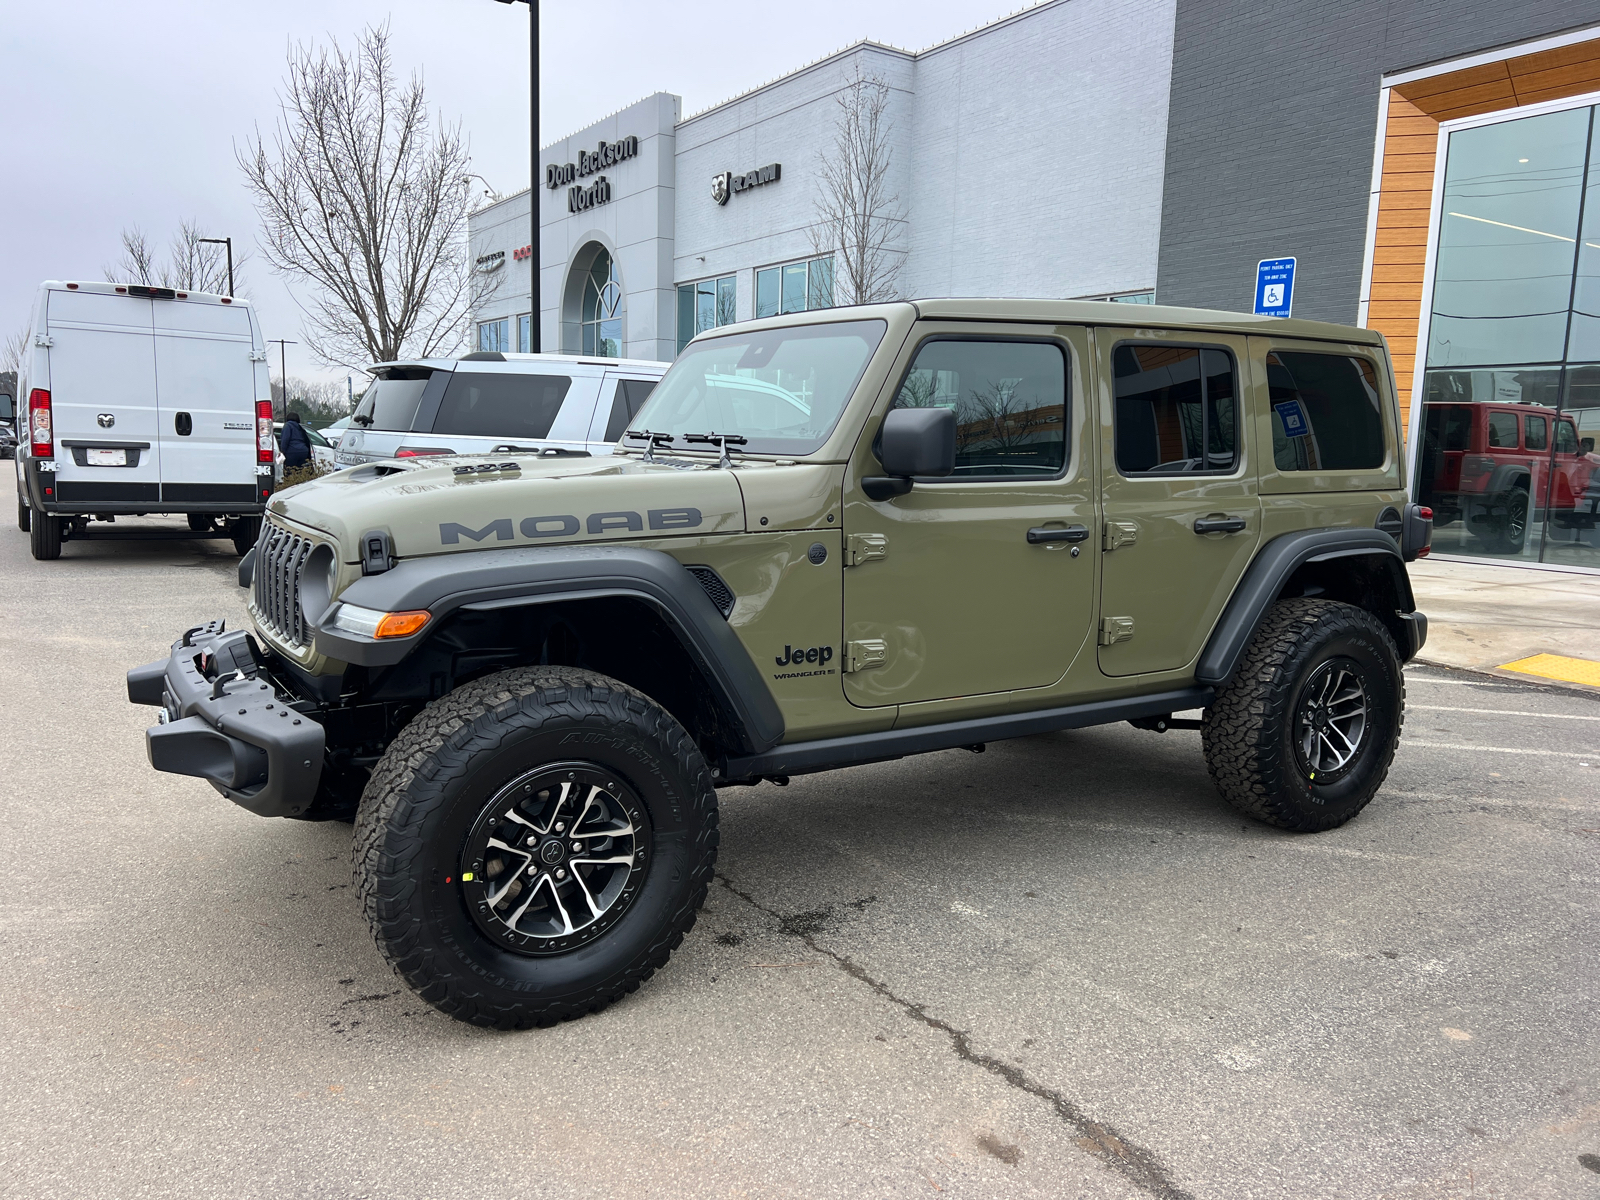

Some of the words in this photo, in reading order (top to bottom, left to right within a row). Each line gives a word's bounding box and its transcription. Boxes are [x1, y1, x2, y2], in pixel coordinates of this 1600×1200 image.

[546, 164, 575, 189] Don
[574, 135, 637, 177] Jackson
[730, 163, 781, 193] RAM
[568, 176, 610, 213] North
[513, 245, 532, 260] DOD
[438, 507, 703, 545] MOAB
[775, 644, 833, 666] Jeep
[773, 669, 826, 680] WRANGLER
